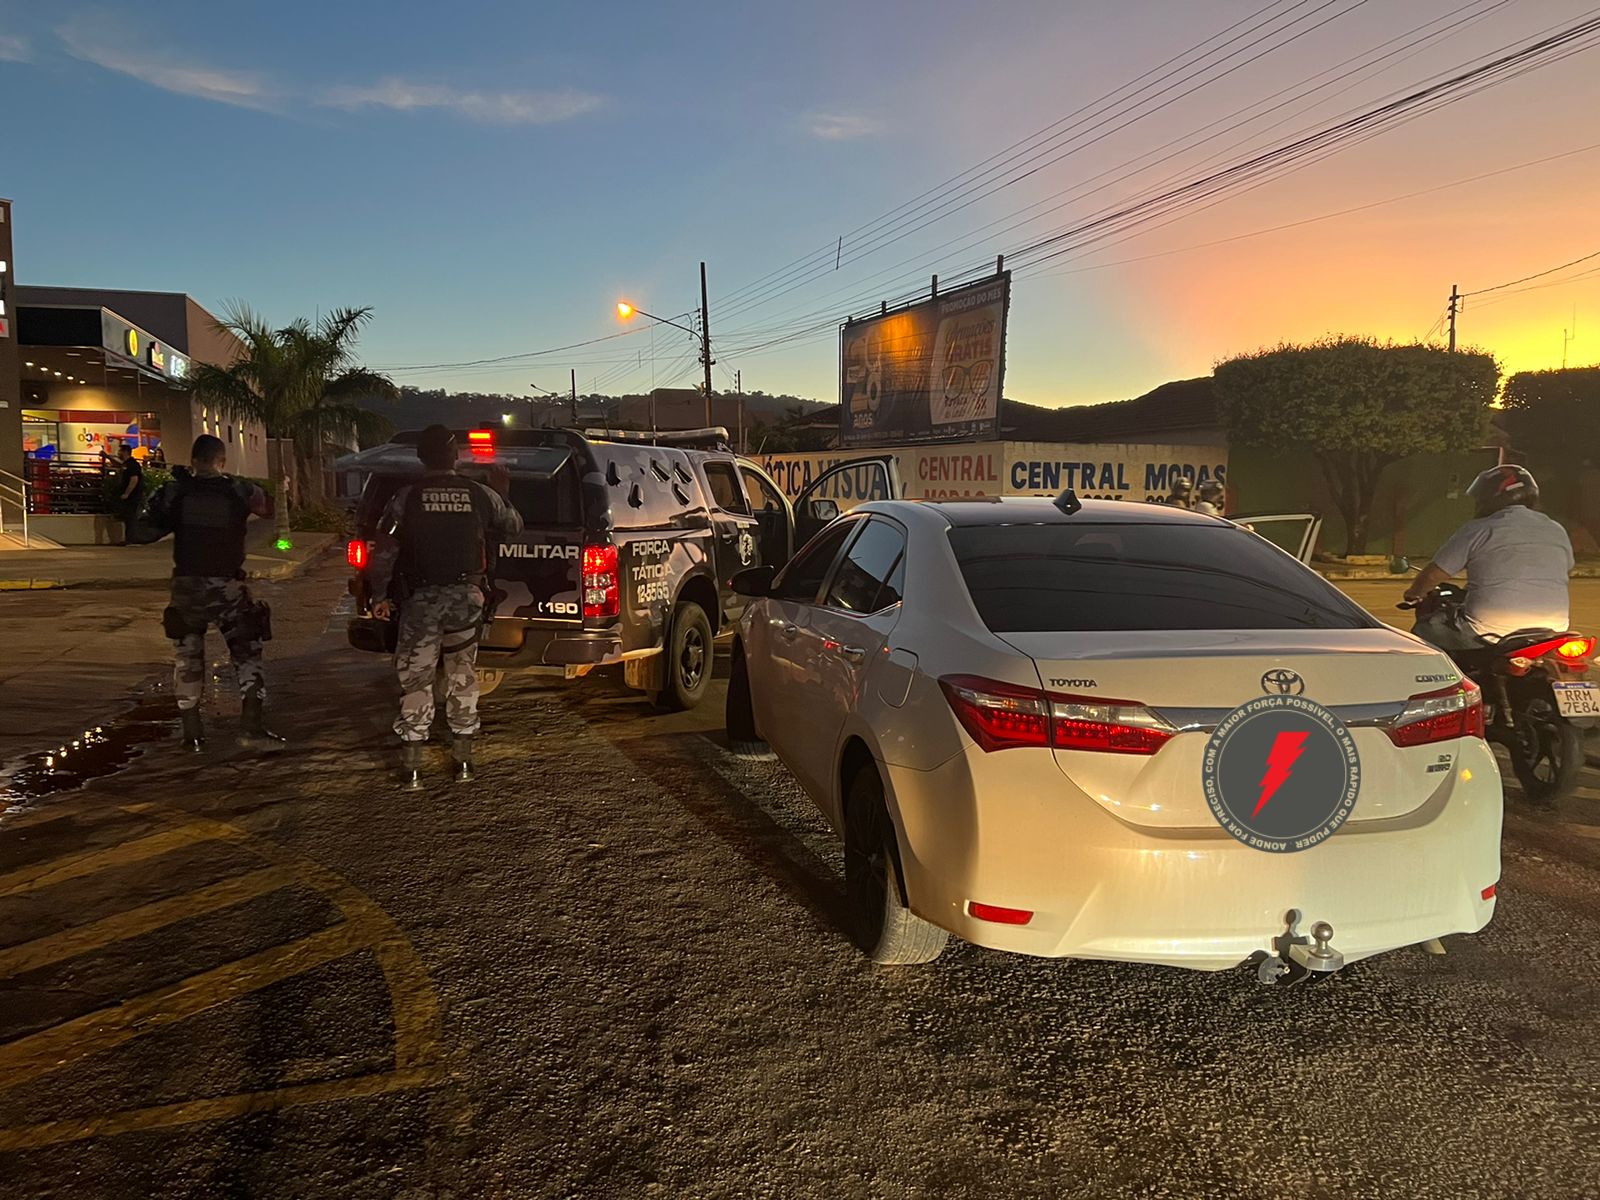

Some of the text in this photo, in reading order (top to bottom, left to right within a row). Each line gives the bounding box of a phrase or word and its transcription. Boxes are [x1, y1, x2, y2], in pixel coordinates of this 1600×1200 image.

[918, 455, 997, 480] CENTRAL
[1011, 461, 1225, 490] CENTRAL MODAS
[499, 544, 579, 559] MILITAR
[632, 540, 670, 559] FORÇA
[545, 602, 579, 614] 190
[1049, 678, 1097, 687] TOYOTA
[1565, 690, 1592, 701] RRM
[1564, 701, 1599, 713] 7E84
